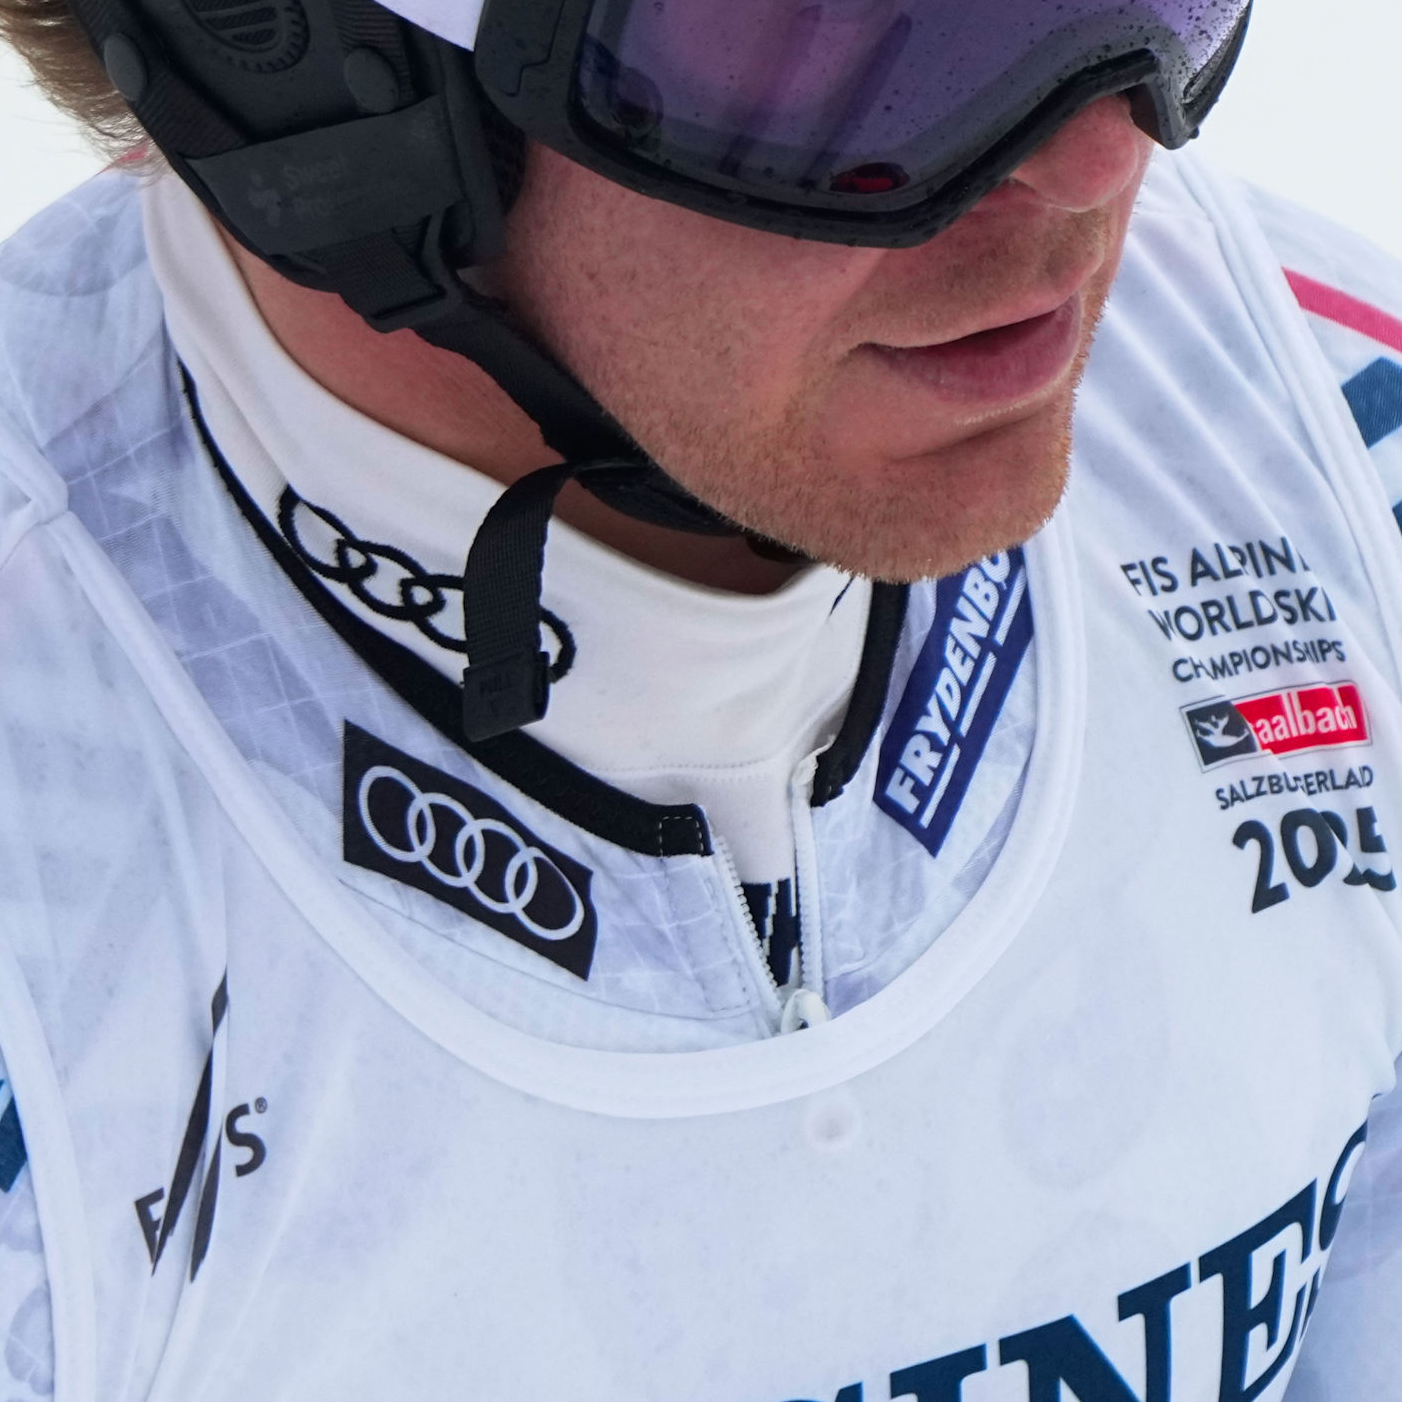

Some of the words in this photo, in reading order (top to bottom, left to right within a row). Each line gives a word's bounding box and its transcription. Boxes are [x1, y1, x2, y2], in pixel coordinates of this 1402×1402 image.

[1120, 555, 1179, 597] FIS
[1190, 536, 1311, 588] ALPIN
[1249, 686, 1358, 745] aalbach
[1215, 764, 1374, 811] SALZBUERLAD
